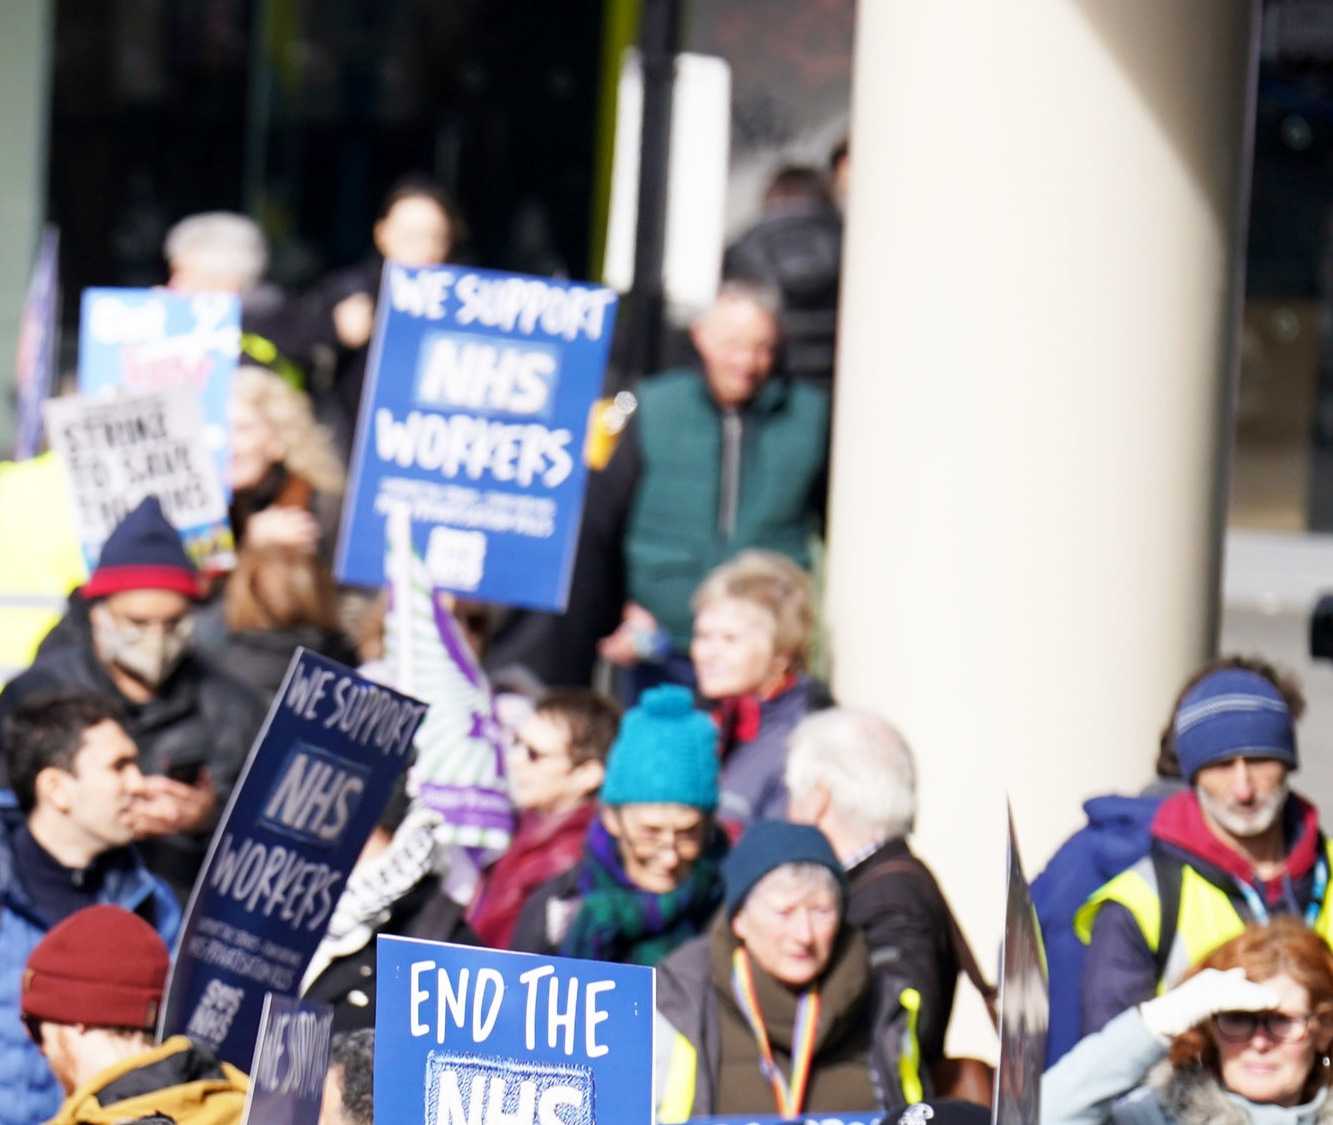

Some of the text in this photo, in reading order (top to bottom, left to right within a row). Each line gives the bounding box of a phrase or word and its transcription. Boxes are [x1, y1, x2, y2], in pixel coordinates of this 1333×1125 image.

[390, 267, 618, 341] WE SUPPORT
[419, 338, 557, 414] NHS
[375, 408, 574, 488] WORKERS
[286, 662, 426, 757] WE SUPPORT
[264, 752, 365, 842] NHS
[210, 832, 343, 933] WORKERS
[410, 960, 616, 1058] END THE
